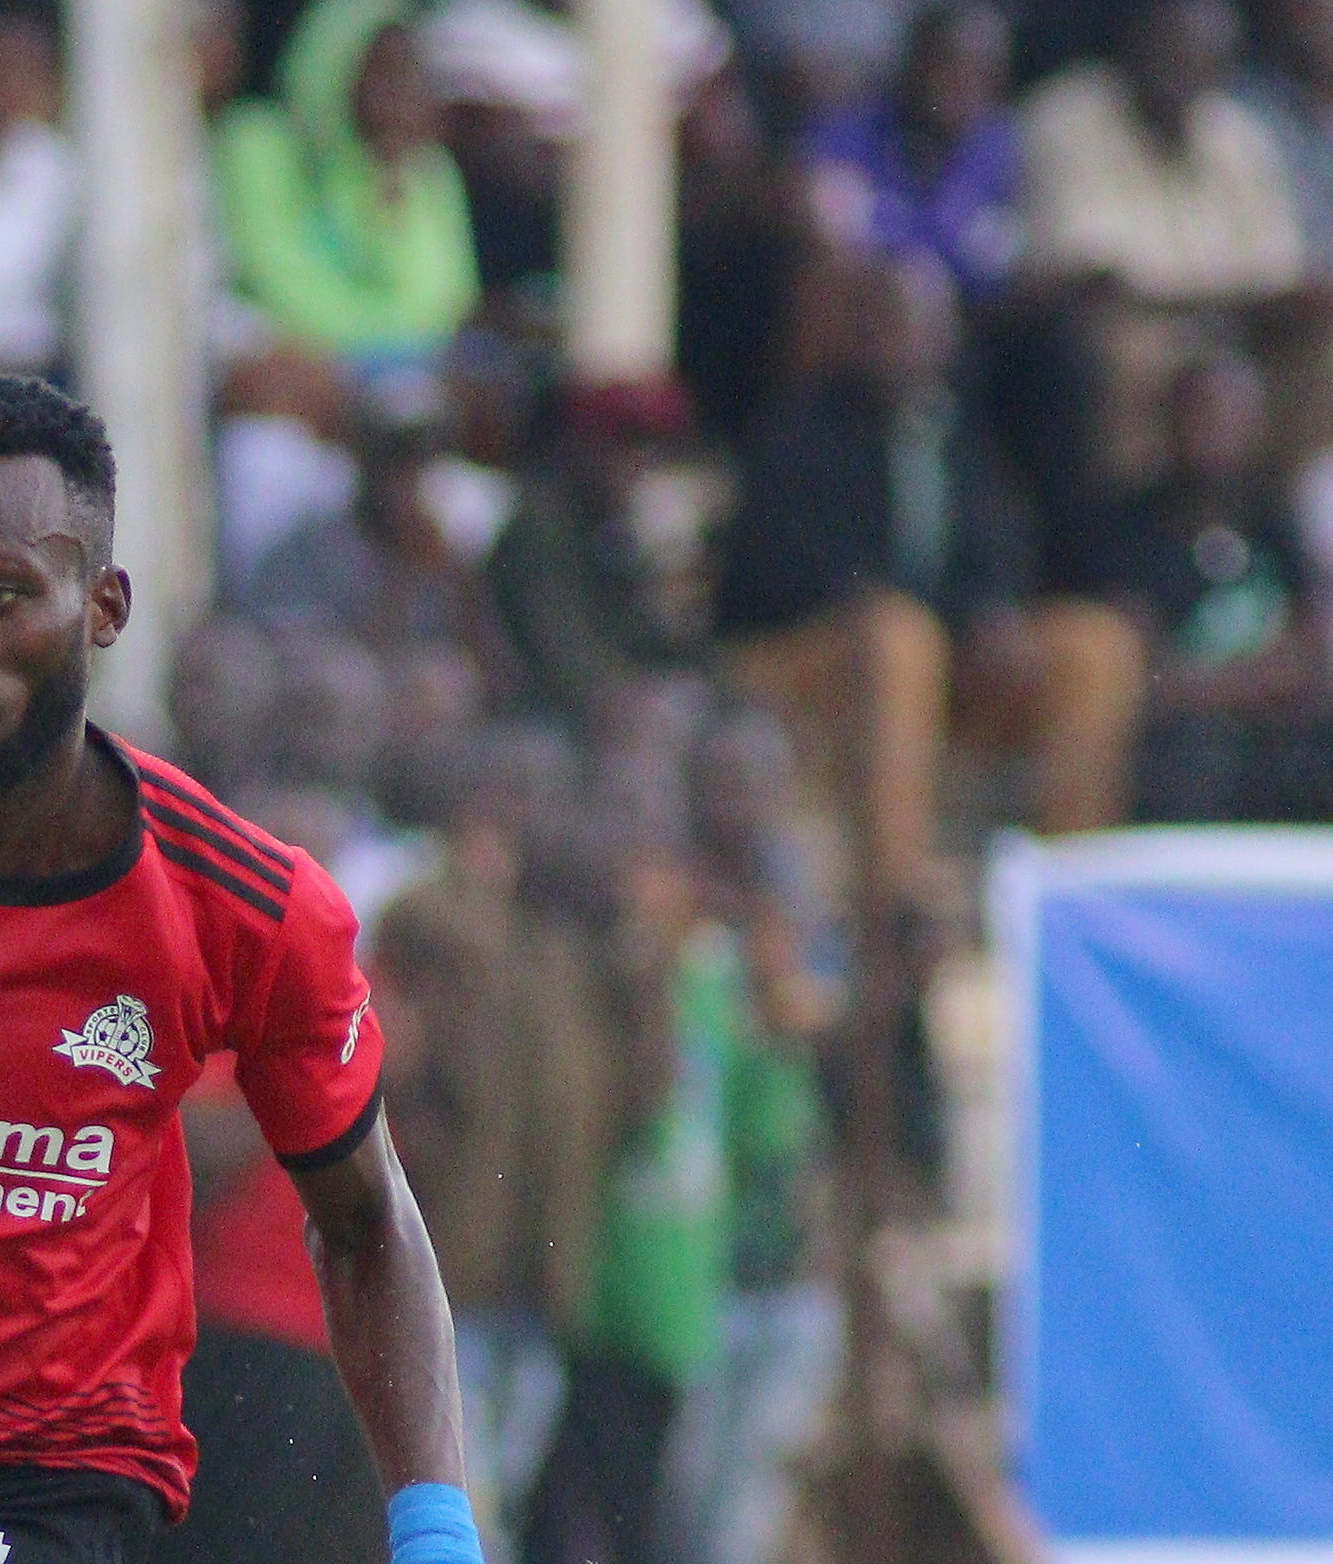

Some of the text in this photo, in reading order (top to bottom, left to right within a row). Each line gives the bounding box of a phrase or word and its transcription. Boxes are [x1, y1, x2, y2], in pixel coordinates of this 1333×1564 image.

[86, 1007, 115, 1034] SPORTS
[138, 1026, 148, 1051] CLUB
[79, 1049, 133, 1077] VIPERS
